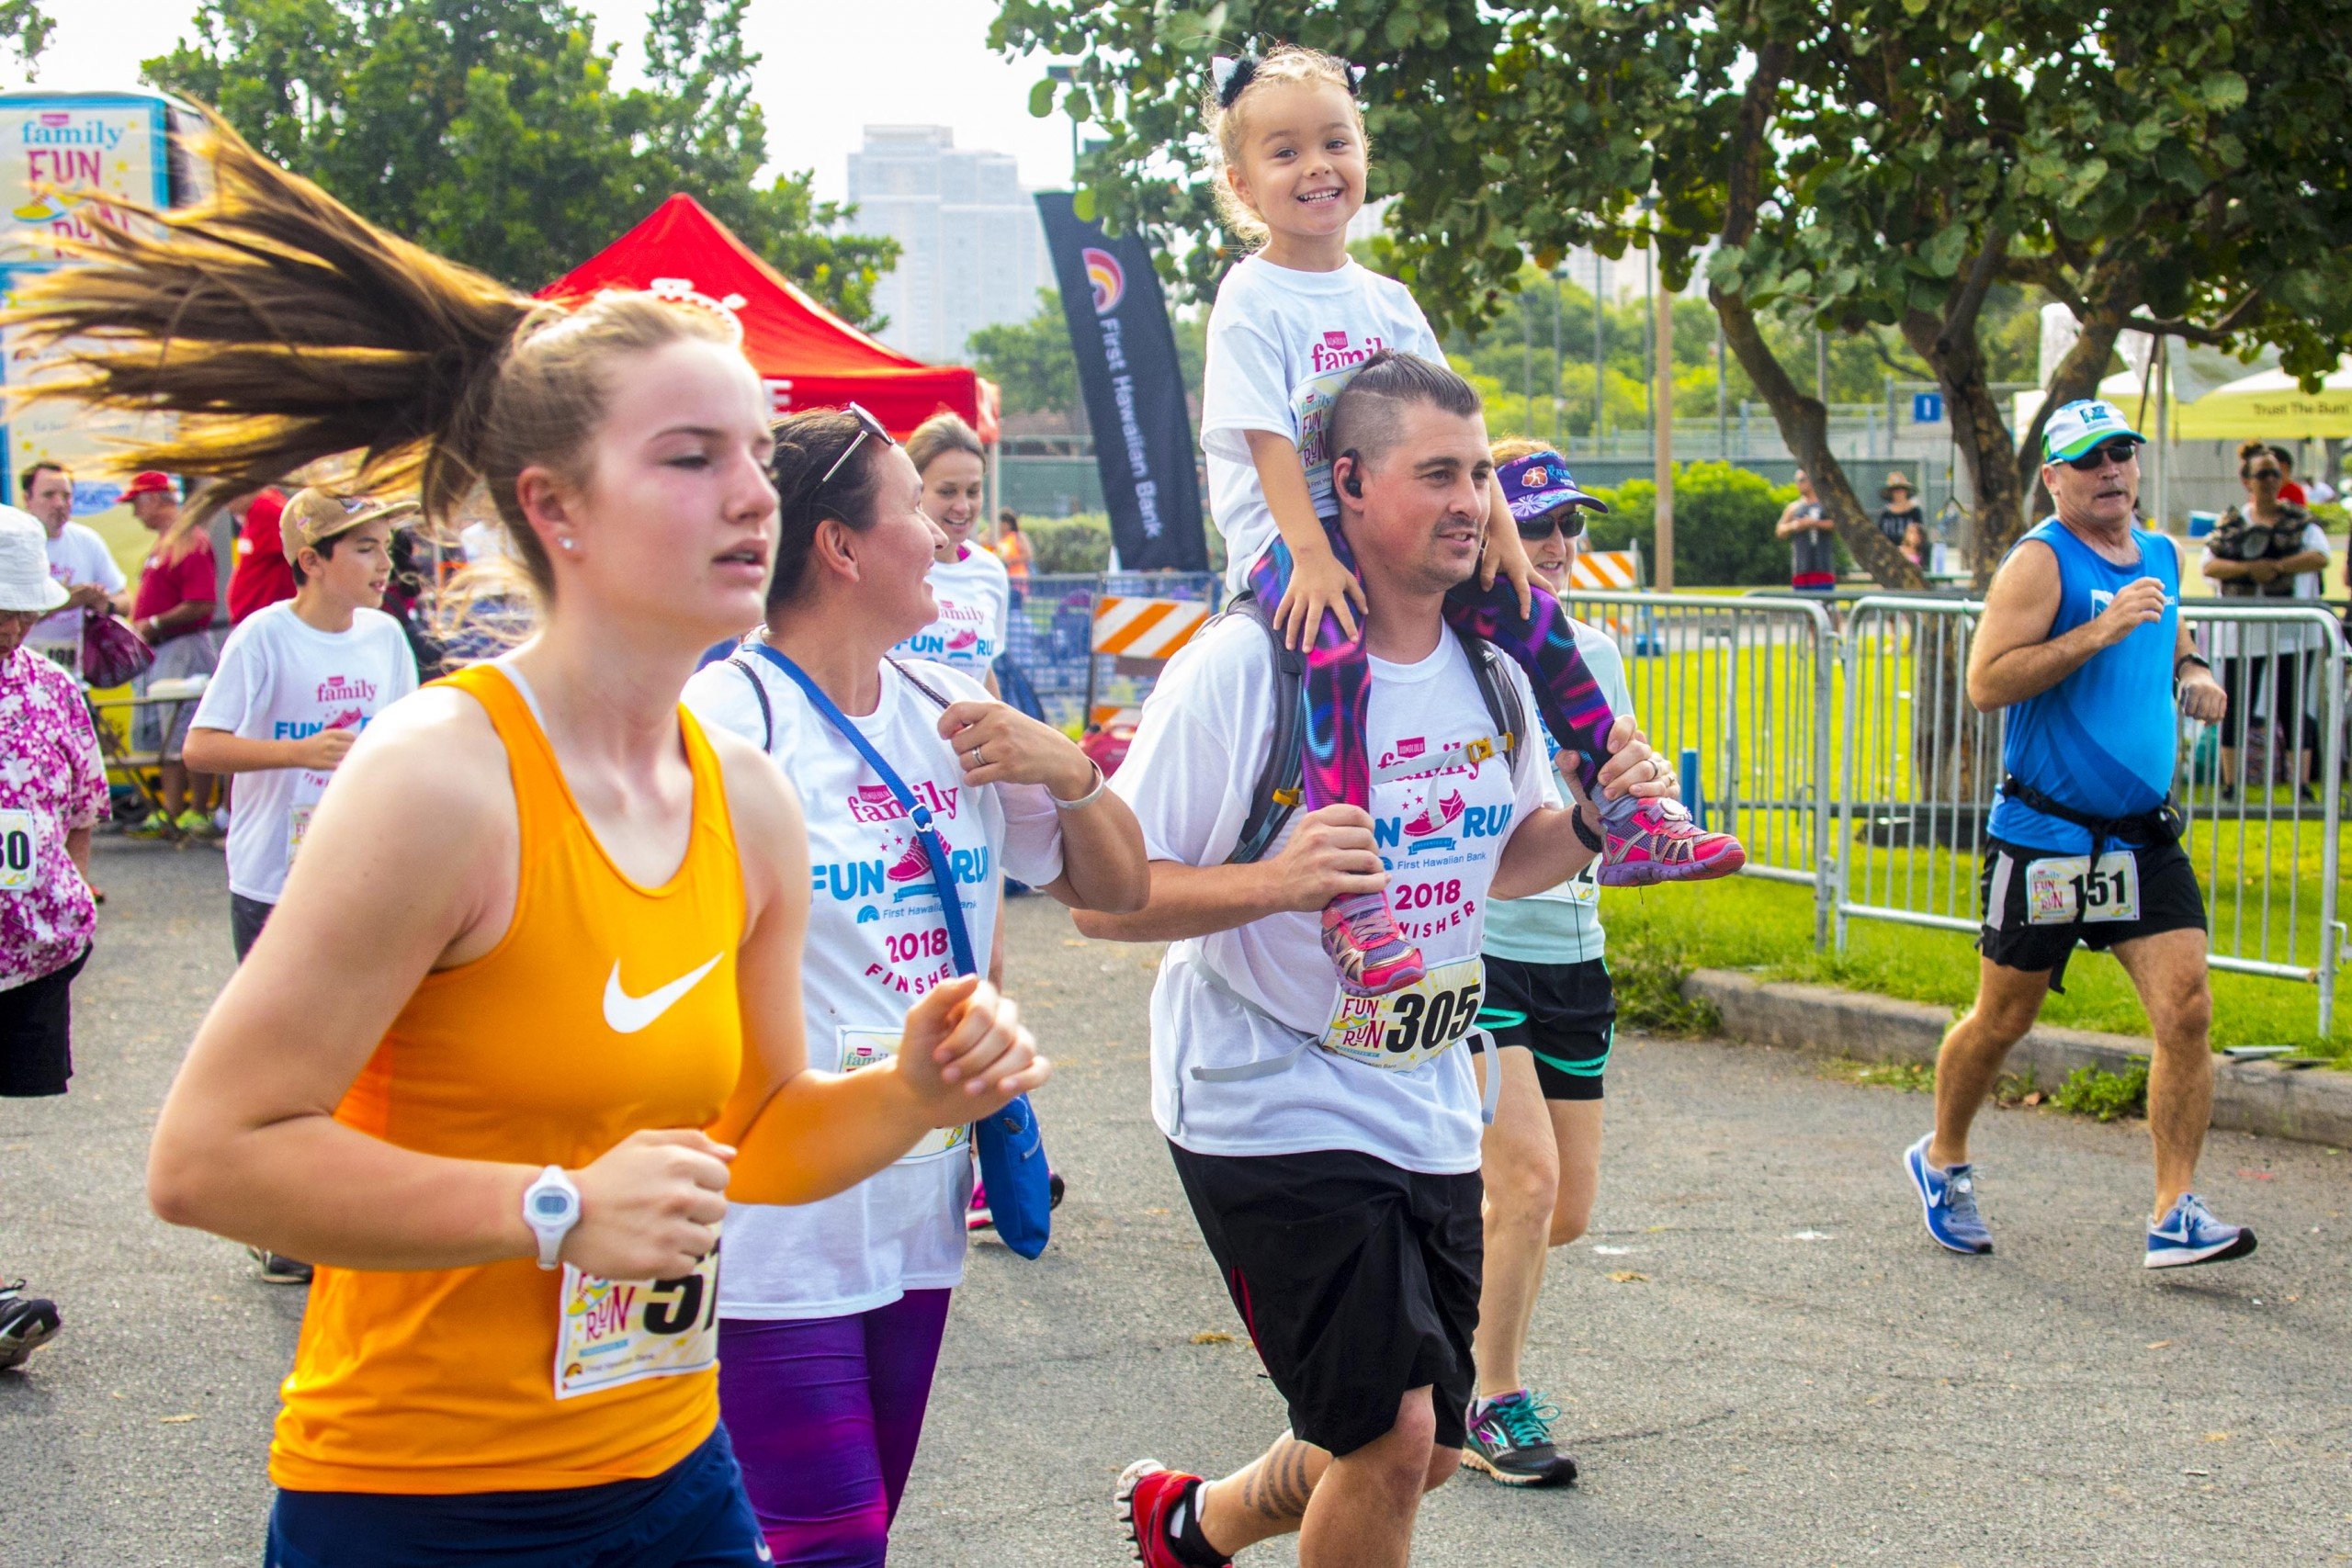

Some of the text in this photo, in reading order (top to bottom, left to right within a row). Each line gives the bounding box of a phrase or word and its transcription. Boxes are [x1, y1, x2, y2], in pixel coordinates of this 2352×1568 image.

[23, 121, 123, 150] family
[28, 150, 100, 195] FUN
[1100, 318, 1163, 539] First Hawaiian Bank
[1302, 410, 1322, 440] FUN
[317, 679, 377, 703] family
[274, 721, 323, 740] FUN
[0, 831, 29, 871] 0
[1397, 852, 1487, 870] First Hawaiian Bank
[1395, 879, 1462, 911] 2018
[2069, 870, 2126, 910] 151
[883, 908, 905, 918] First
[908, 903, 944, 916] Hawaiia
[885, 928, 948, 964] 2018
[1342, 998, 1380, 1019] FUN
[1385, 983, 1481, 1054] 305
[1343, 1021, 1385, 1049] RUN
[586, 1285, 636, 1342] RUN
